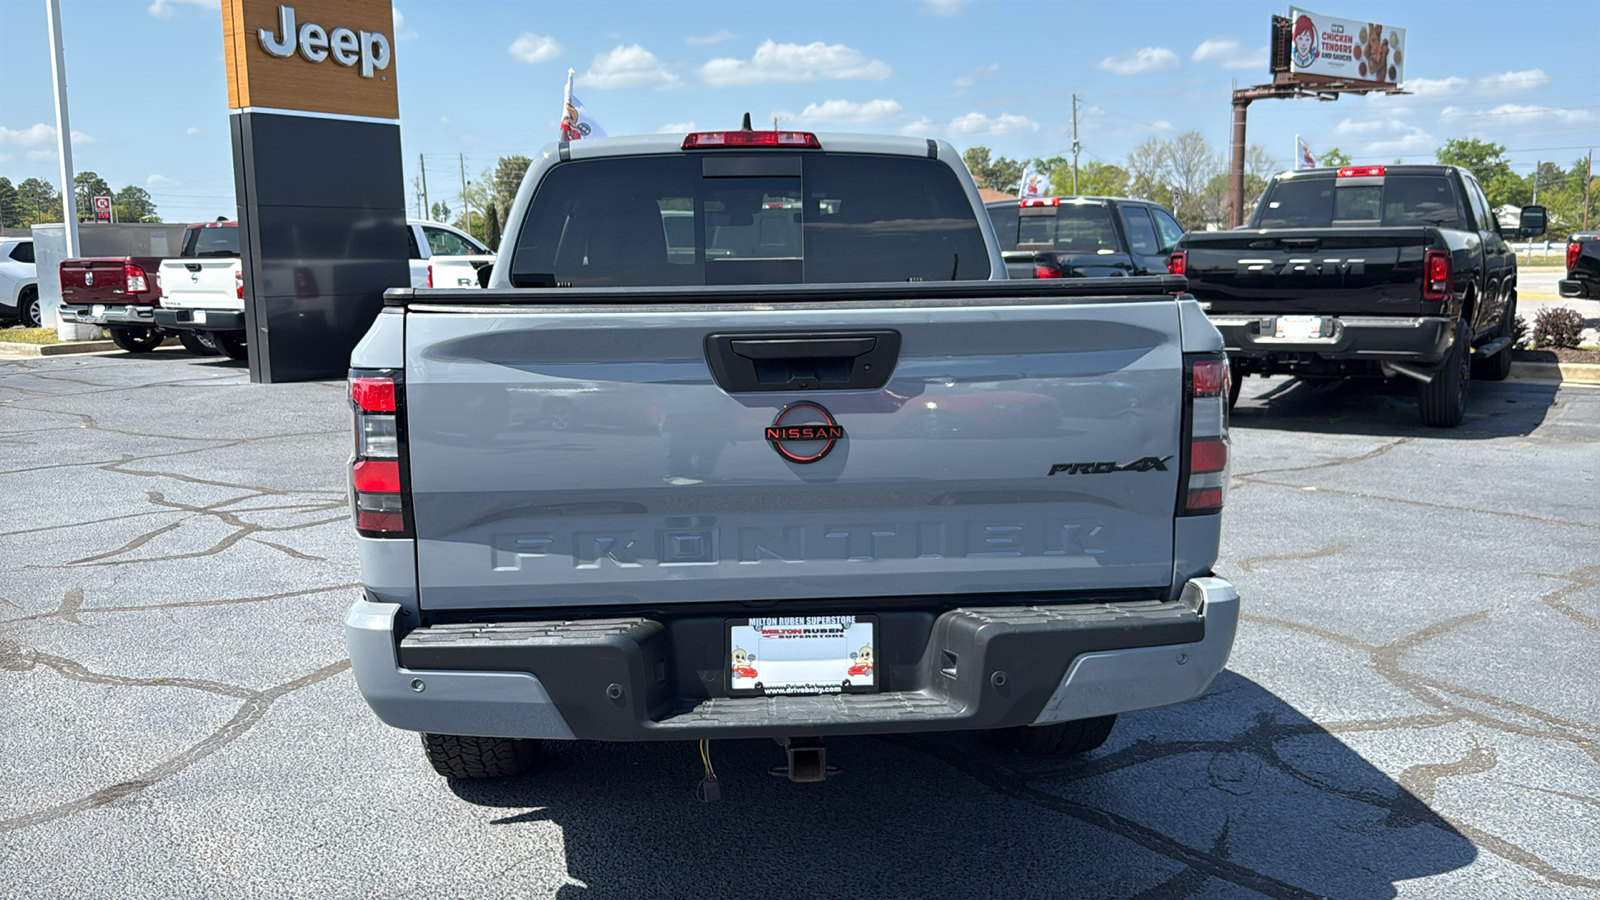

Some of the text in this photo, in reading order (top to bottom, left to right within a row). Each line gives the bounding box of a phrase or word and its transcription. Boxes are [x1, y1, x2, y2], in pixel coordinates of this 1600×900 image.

[257, 4, 391, 79] Jeep
[1321, 31, 1353, 44] CHICKEN
[1321, 42, 1353, 54] TENDERS
[1333, 53, 1352, 62] SAUCES
[1237, 258, 1366, 276] RAM
[767, 428, 841, 439] NISSAN
[491, 518, 1106, 572] FRONTIER
[749, 615, 856, 627] MILTON RUBEN SUPERSTORE
[764, 686, 842, 694] www.drivebaby.com
